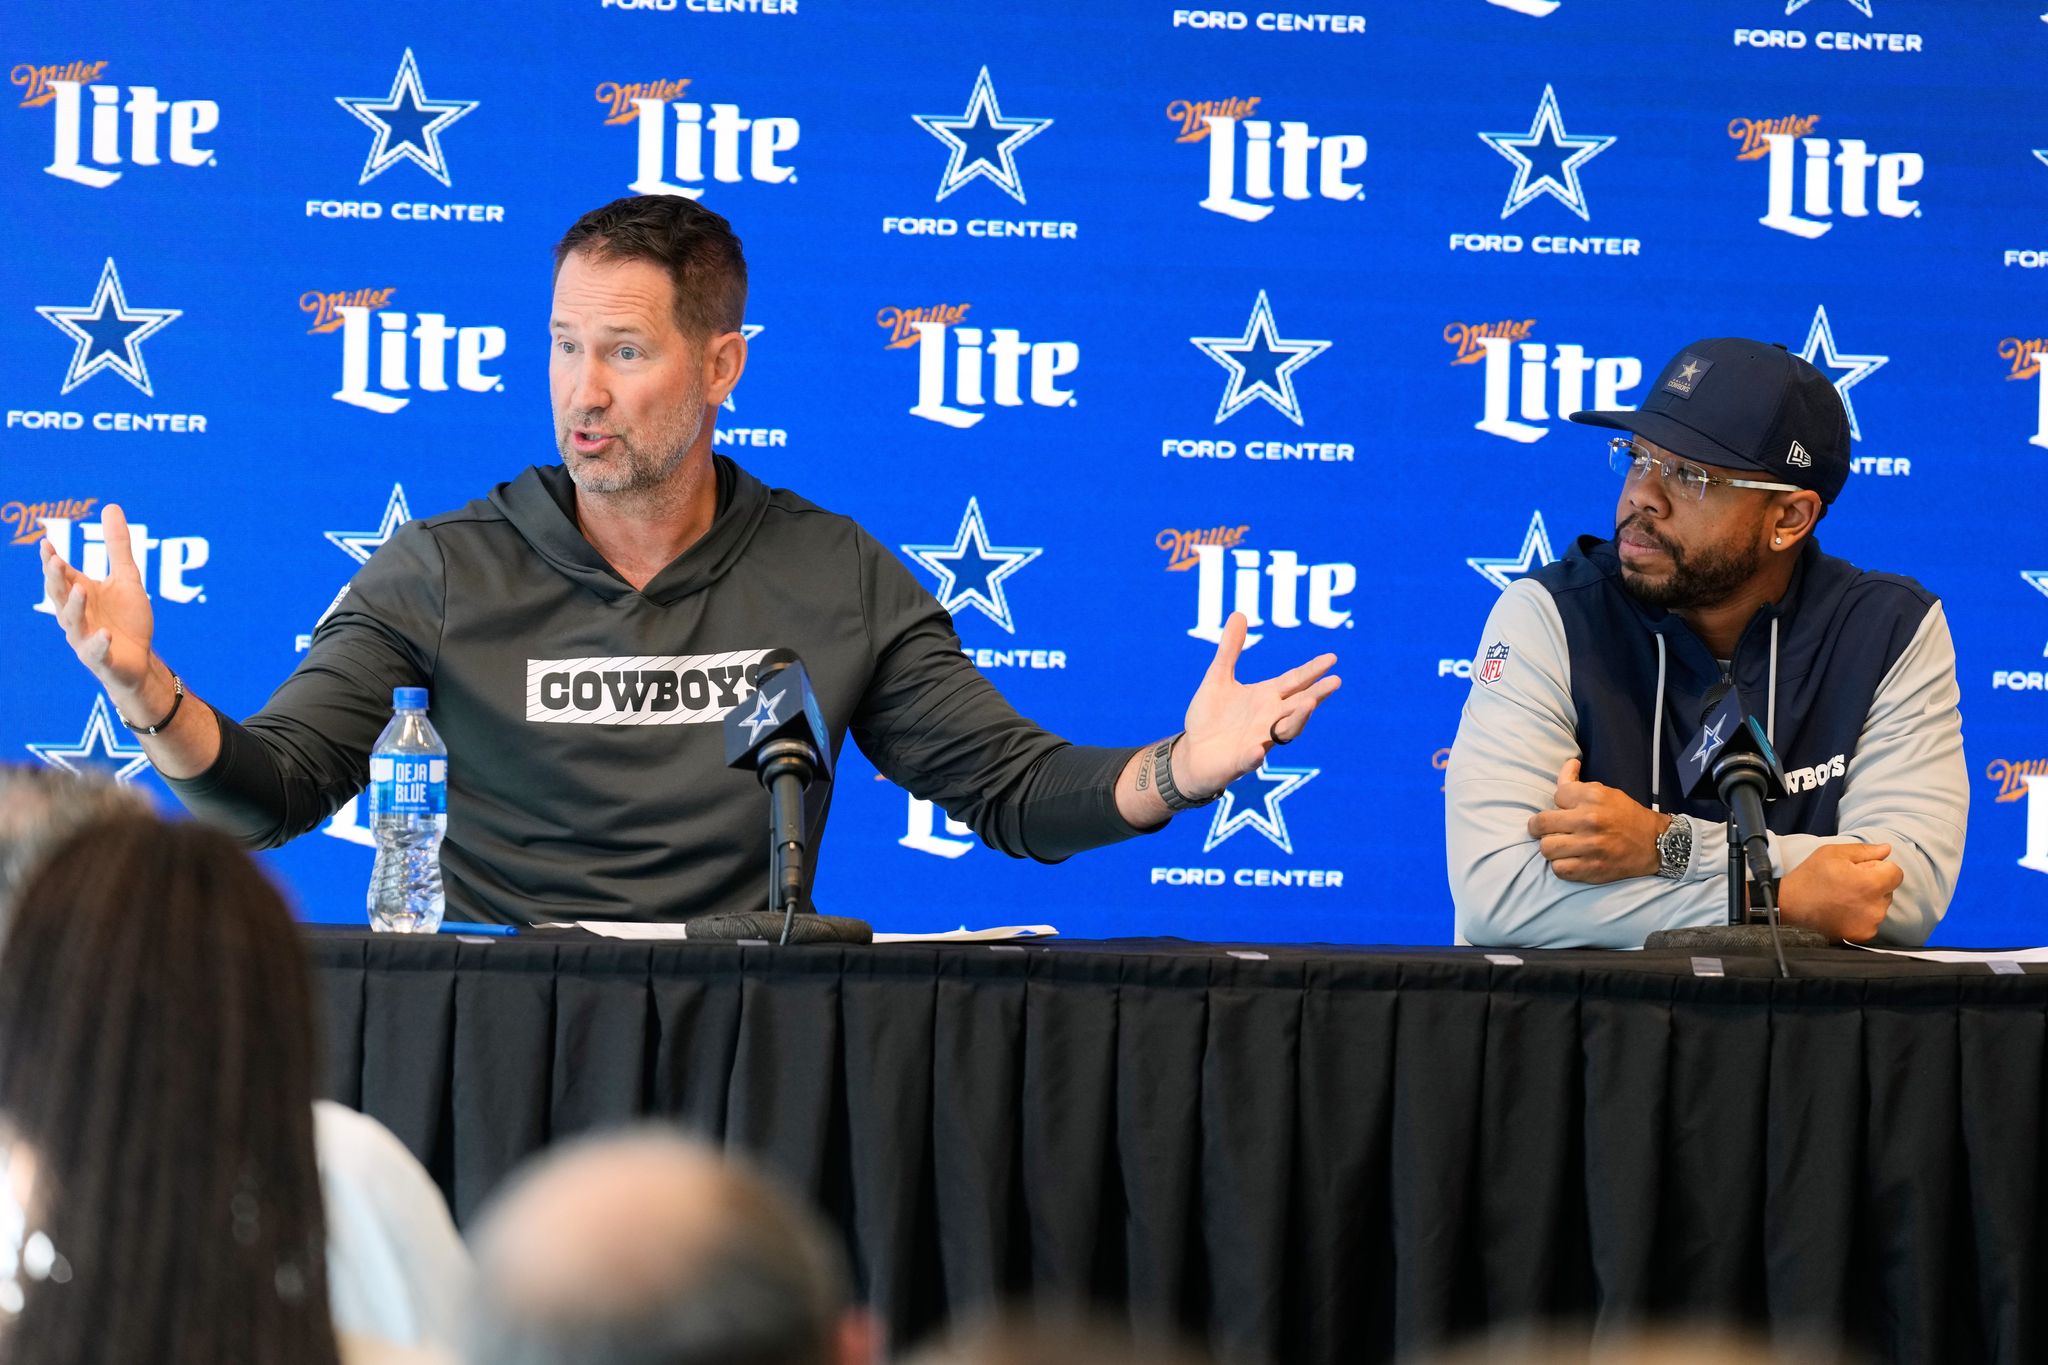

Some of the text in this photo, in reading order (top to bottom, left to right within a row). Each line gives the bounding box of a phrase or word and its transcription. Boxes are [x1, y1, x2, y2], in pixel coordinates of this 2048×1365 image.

[686, 0, 798, 14] CENTER
[1174, 10, 1365, 33] FORD CENTER
[1735, 29, 1922, 52] FORD CENTER
[11, 60, 108, 107] Miller
[596, 78, 692, 125] Miller
[44, 80, 219, 188] Lite
[1167, 96, 1261, 143] Miller
[1728, 114, 1820, 160] Miller
[628, 98, 800, 200] Lite
[1199, 115, 1367, 222] Lite
[1759, 133, 1924, 239] Lite
[306, 200, 504, 222] FORD CENTER
[883, 217, 1077, 239] FORD CENTER
[1450, 234, 1640, 256] FORD CENTER
[2004, 250, 2048, 268] FOR
[300, 287, 396, 334] Miller
[877, 303, 971, 350] Miller
[332, 305, 506, 414] Lite
[1444, 319, 1537, 365] Miller
[909, 320, 1079, 429] Lite
[1475, 337, 1642, 443] Lite
[7, 410, 207, 433] FORD CENTER
[714, 428, 787, 447] NTER
[1163, 439, 1354, 462] FORD CENTER
[1850, 457, 1911, 477] NTER
[1, 498, 98, 544] Miller
[1156, 526, 1249, 571] Miller
[1187, 543, 1356, 649] Lite
[1438, 659, 1473, 678] FO
[1482, 659, 1502, 681] NFL
[1992, 671, 2048, 690] FOR
[395, 763, 428, 782] DEJA
[395, 783, 427, 803] BLUE
[1784, 753, 1846, 795] WBOYS
[1151, 867, 1344, 889] FORD CENTER
